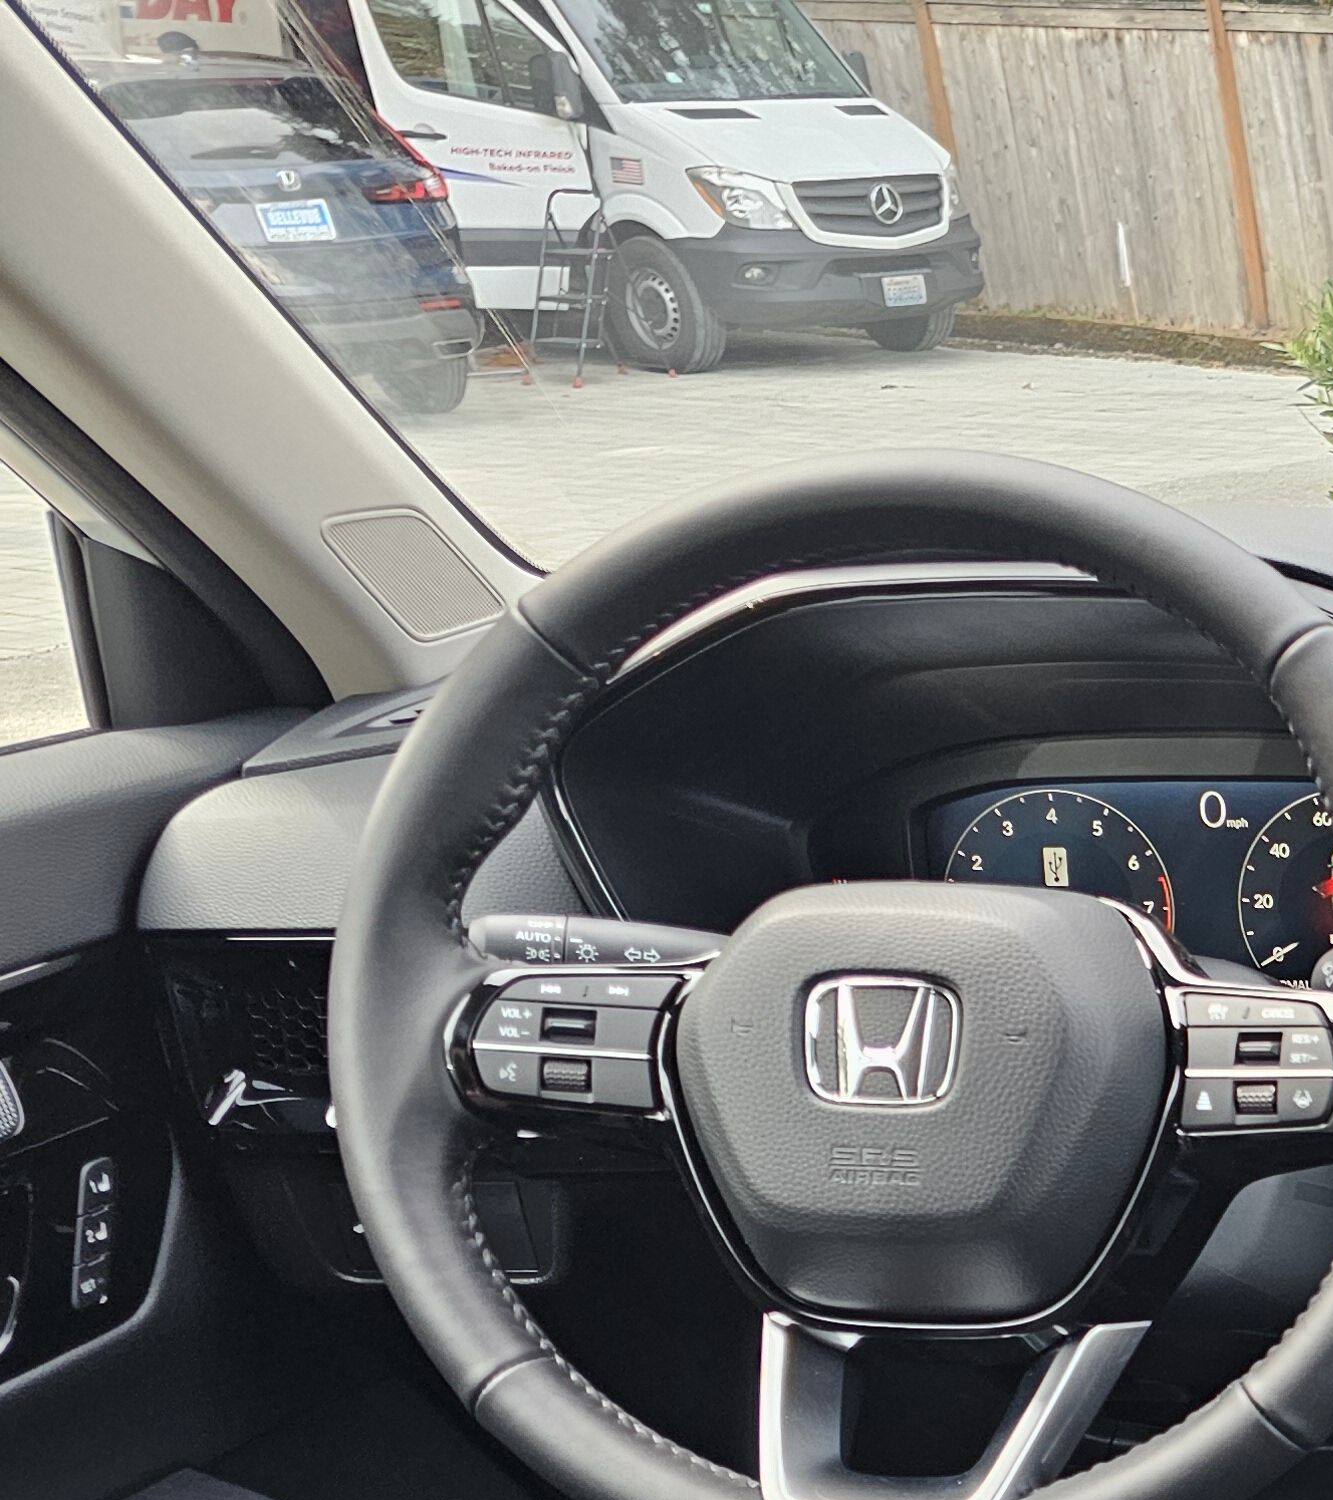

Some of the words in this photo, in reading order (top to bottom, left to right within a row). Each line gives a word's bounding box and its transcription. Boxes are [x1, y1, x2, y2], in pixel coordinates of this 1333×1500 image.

[450, 146, 513, 158] HIGH-TECH
[515, 147, 573, 160] INFRARED
[1046, 807, 1059, 825] 4
[1199, 790, 1227, 828] 0
[1226, 817, 1249, 830] mph
[1312, 811, 1332, 827] 60
[1002, 820, 1014, 837] 3
[1092, 820, 1104, 837] 5
[1269, 842, 1290, 859] 40
[971, 855, 983, 871] 2
[1128, 854, 1140, 871] 6
[1142, 900, 1155, 914] 7
[1253, 893, 1274, 909] 20
[515, 930, 552, 943] AUTO
[829, 1147, 920, 1167] SRS
[829, 1169, 922, 1186] AIRBAG
